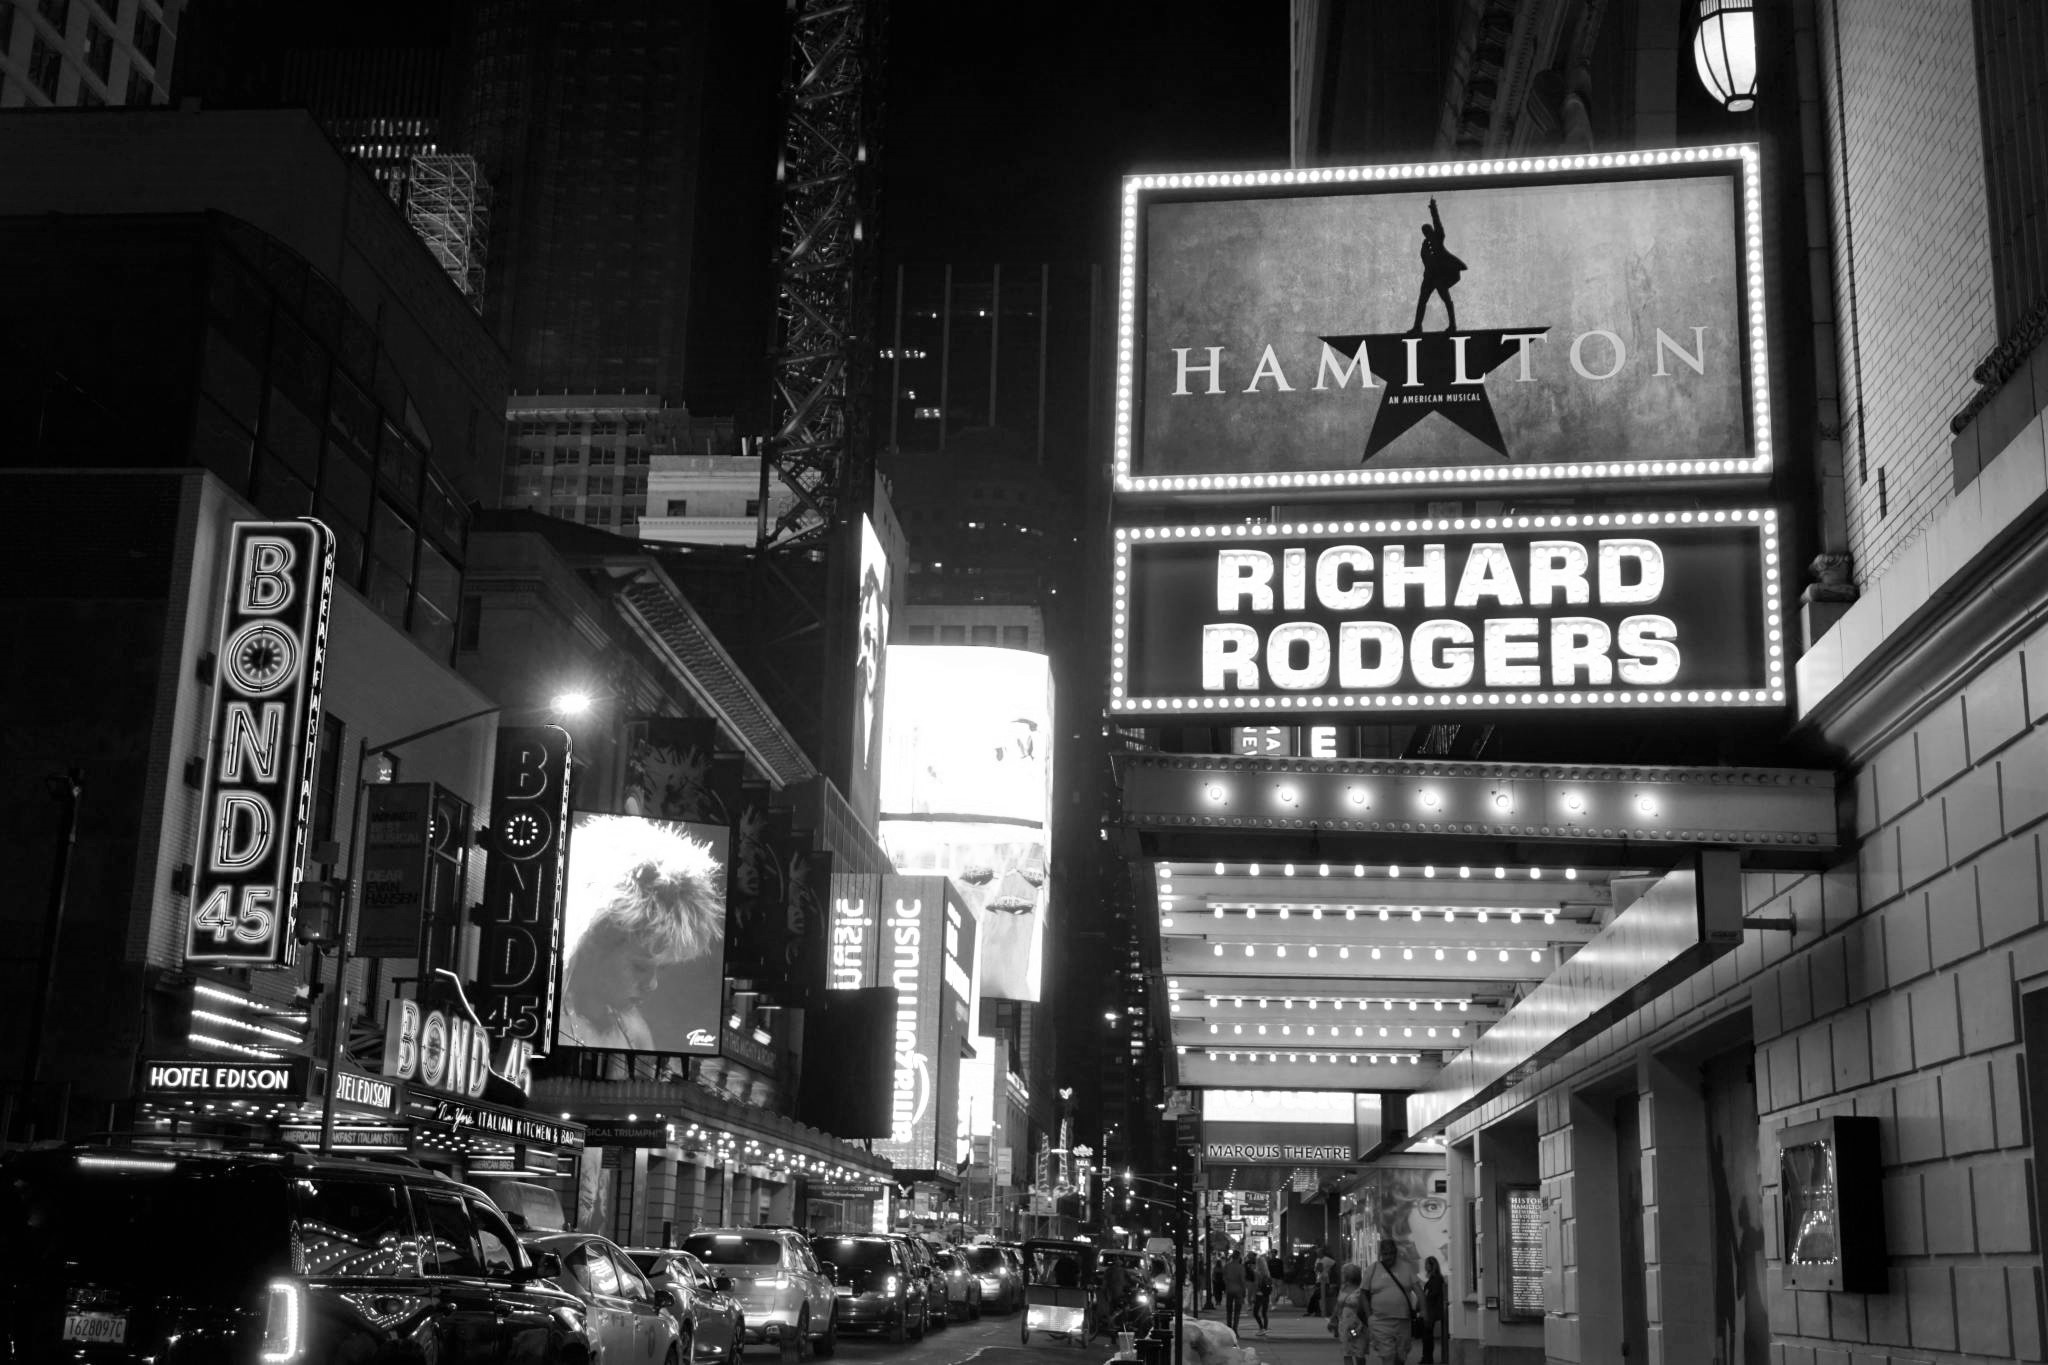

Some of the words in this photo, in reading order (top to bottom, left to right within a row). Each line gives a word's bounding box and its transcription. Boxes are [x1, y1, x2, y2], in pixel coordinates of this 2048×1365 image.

[1171, 325, 1710, 396] HAMILTON
[1388, 395, 1399, 405] AN
[1402, 394, 1443, 404] AMERICAN
[1446, 392, 1481, 403] MUSICAL
[1215, 538, 1666, 613] RICHARD
[307, 552, 333, 759] BREAKFAST
[1201, 615, 1681, 692] RODGERS
[211, 536, 303, 872] BOND
[297, 780, 312, 846] ALL
[365, 881, 400, 893] EVAN
[366, 870, 404, 882] DEAR
[489, 741, 553, 989] BOND
[193, 885, 276, 942] 45
[288, 865, 304, 934] DAY
[364, 892, 418, 905] HANSEN
[887, 898, 922, 1005] music
[482, 994, 540, 1041] 45
[396, 997, 491, 1100] BOND
[503, 1038, 534, 1099] 45
[150, 1066, 210, 1089] HOTEL
[215, 1067, 290, 1090] EDISON
[356, 1077, 393, 1109] EDISON
[357, 1131, 382, 1144] ITALIAN
[383, 1132, 404, 1145] STYLE
[477, 1110, 514, 1135] ITALIAN
[515, 1118, 553, 1143] KITCHEN
[552, 1129, 559, 1144] &
[560, 1129, 575, 1146] BAR
[1207, 1143, 1281, 1161] MARQUIS
[1283, 1144, 1352, 1161] THEATRE
[69, 1318, 123, 1338] T628097C
